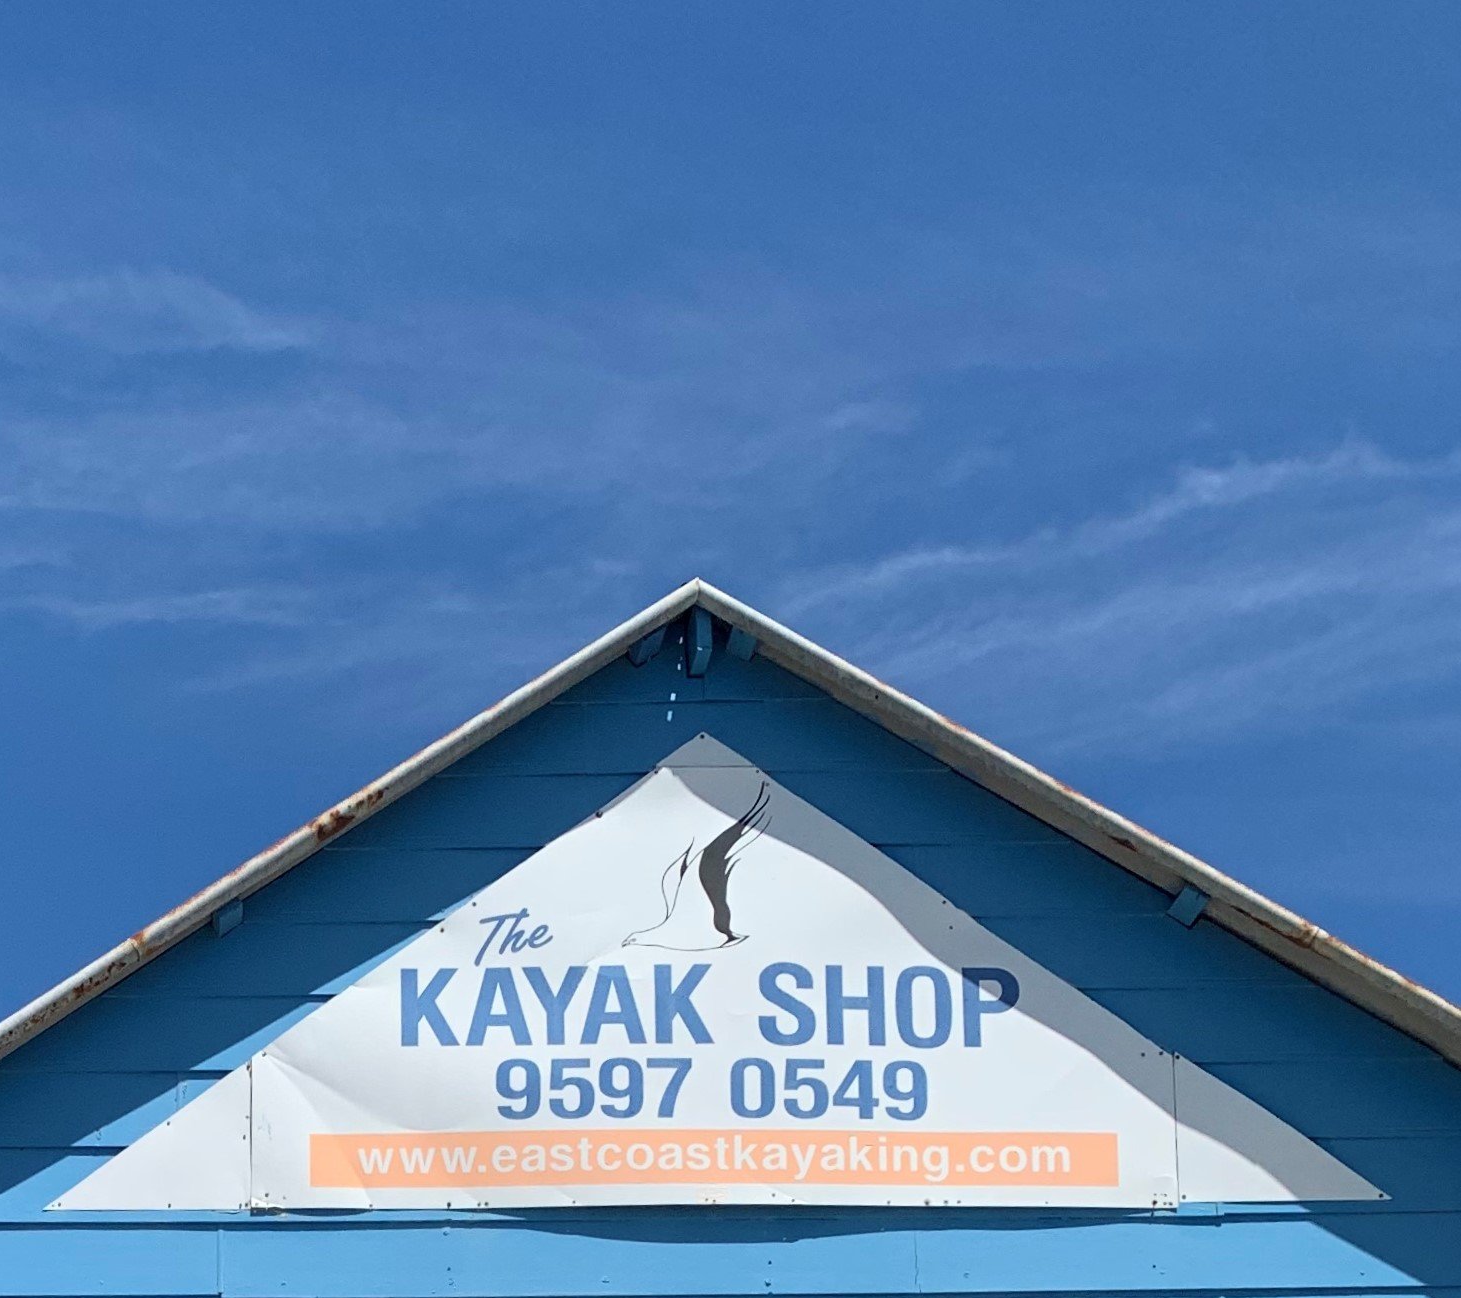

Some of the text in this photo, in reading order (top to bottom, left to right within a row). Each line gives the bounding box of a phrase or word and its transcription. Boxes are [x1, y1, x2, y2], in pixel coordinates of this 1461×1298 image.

[475, 907, 554, 970] The
[398, 960, 1024, 1052] KAYAK SHOP
[495, 1057, 928, 1121] 9597 0549
[355, 1133, 1074, 1188] www.eastcoastkayaking.com
